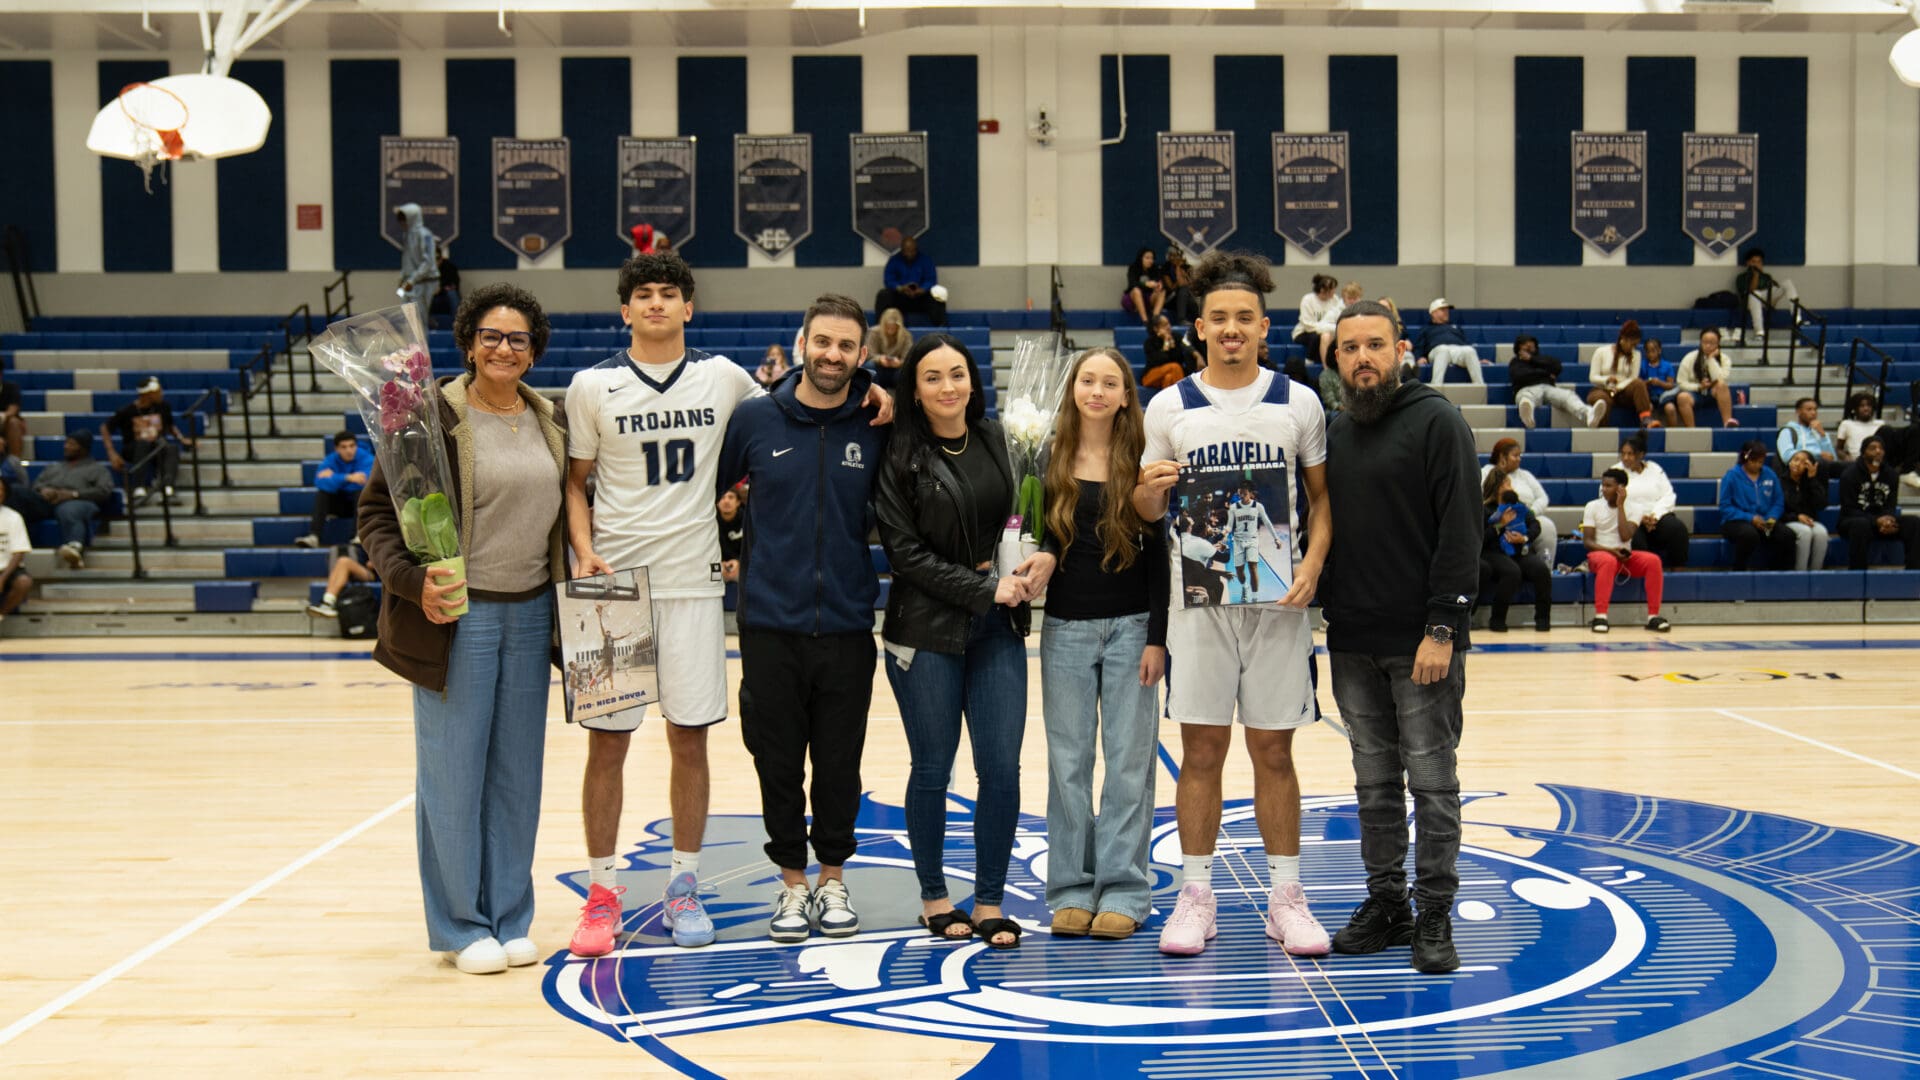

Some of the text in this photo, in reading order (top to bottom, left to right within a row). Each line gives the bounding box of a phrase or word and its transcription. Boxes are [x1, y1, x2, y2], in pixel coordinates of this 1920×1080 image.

[497, 142, 565, 150] FOOTBALL
[1718, 137, 1753, 145] TENNIS
[497, 149, 565, 176] CHAMPIONS
[1162, 143, 1231, 170] CHAMPIONS
[1277, 143, 1345, 170] CHAMPIONS
[1576, 143, 1643, 170] CHAMPIONS
[1687, 144, 1754, 171] CHAMPIONS
[1585, 200, 1632, 208] REGIONAL
[615, 407, 715, 434] TROJANS
[641, 438, 695, 487] 10
[1187, 441, 1285, 465] TARAVELLA
[1199, 464, 1240, 473] JORDAN
[1242, 461, 1286, 470] ARRIAGA
[1243, 521, 1248, 531] 1
[596, 697, 617, 707] NICO
[618, 690, 647, 702] NOVOA
